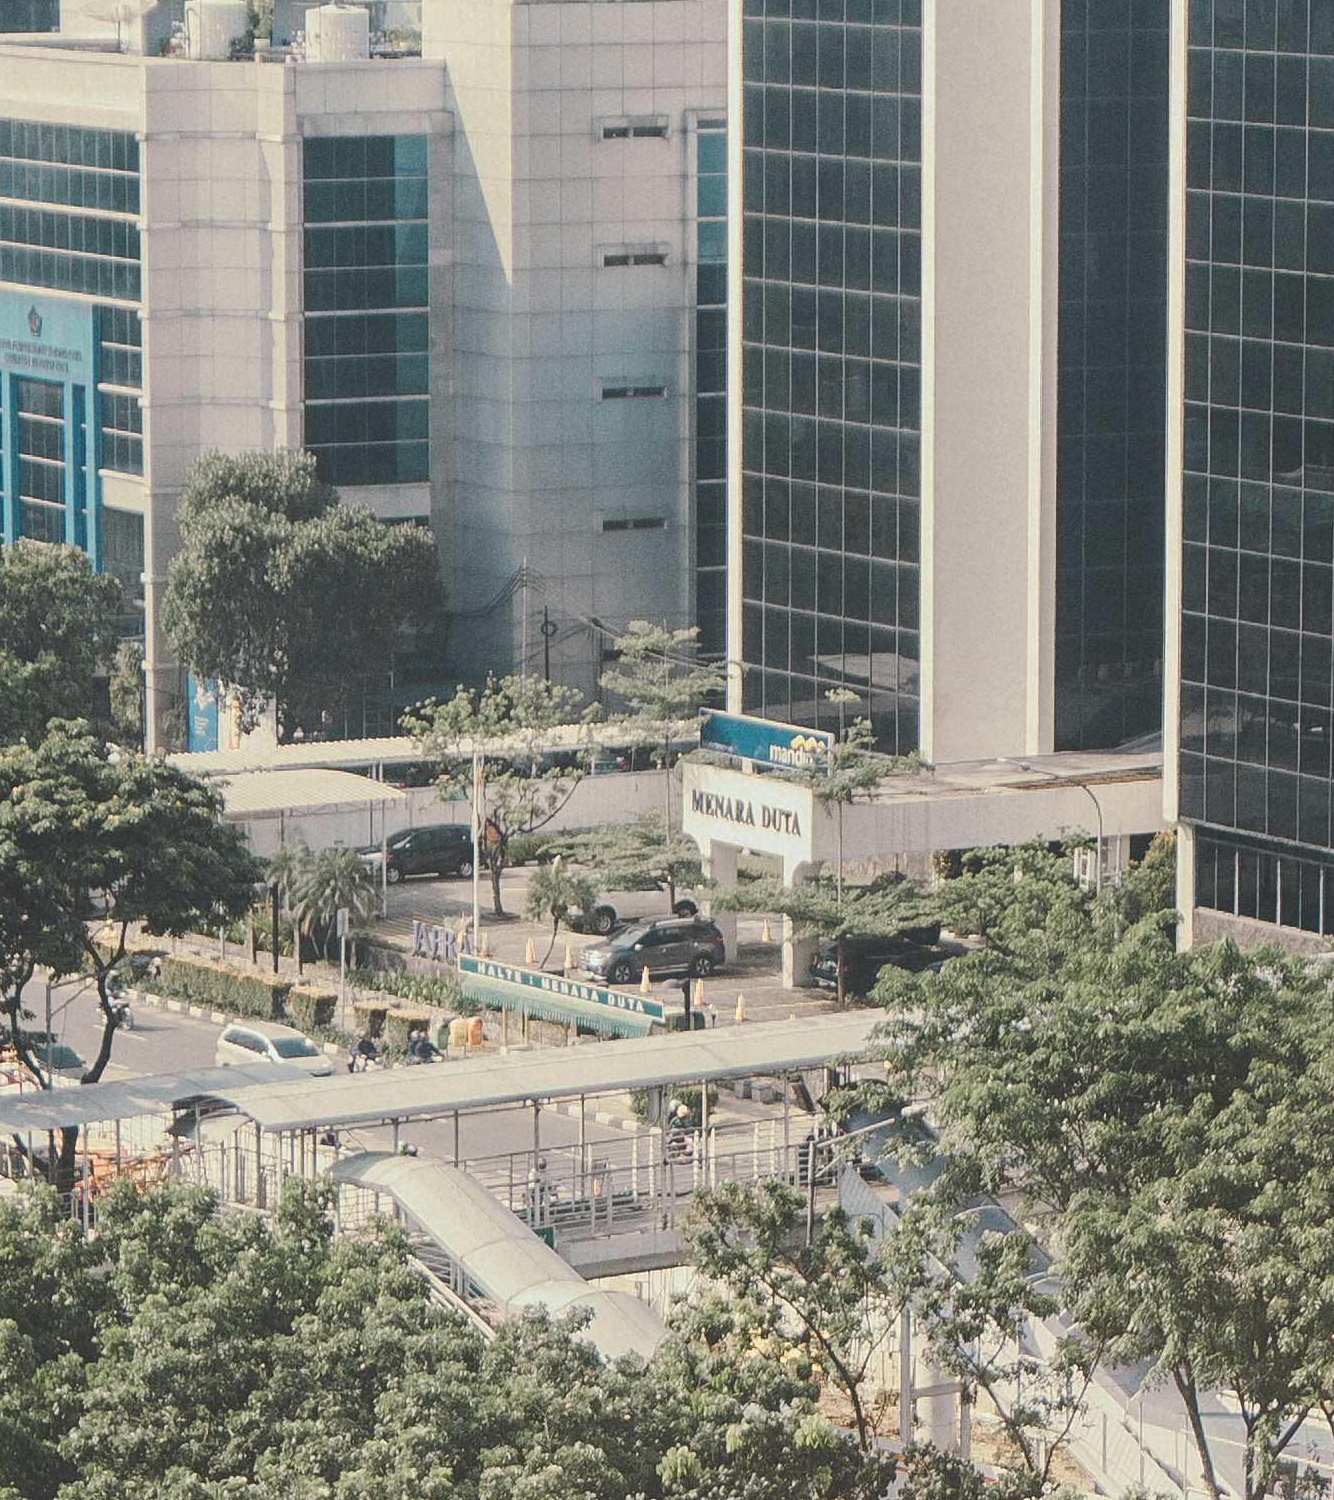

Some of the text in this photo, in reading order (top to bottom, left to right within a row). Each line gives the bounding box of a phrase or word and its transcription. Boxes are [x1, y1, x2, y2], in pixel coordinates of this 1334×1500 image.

[692, 788, 801, 837] MENARA DUTA
[478, 961, 522, 984] HALTE
[542, 977, 599, 1002] MENARA
[607, 993, 645, 1013] DUTA
